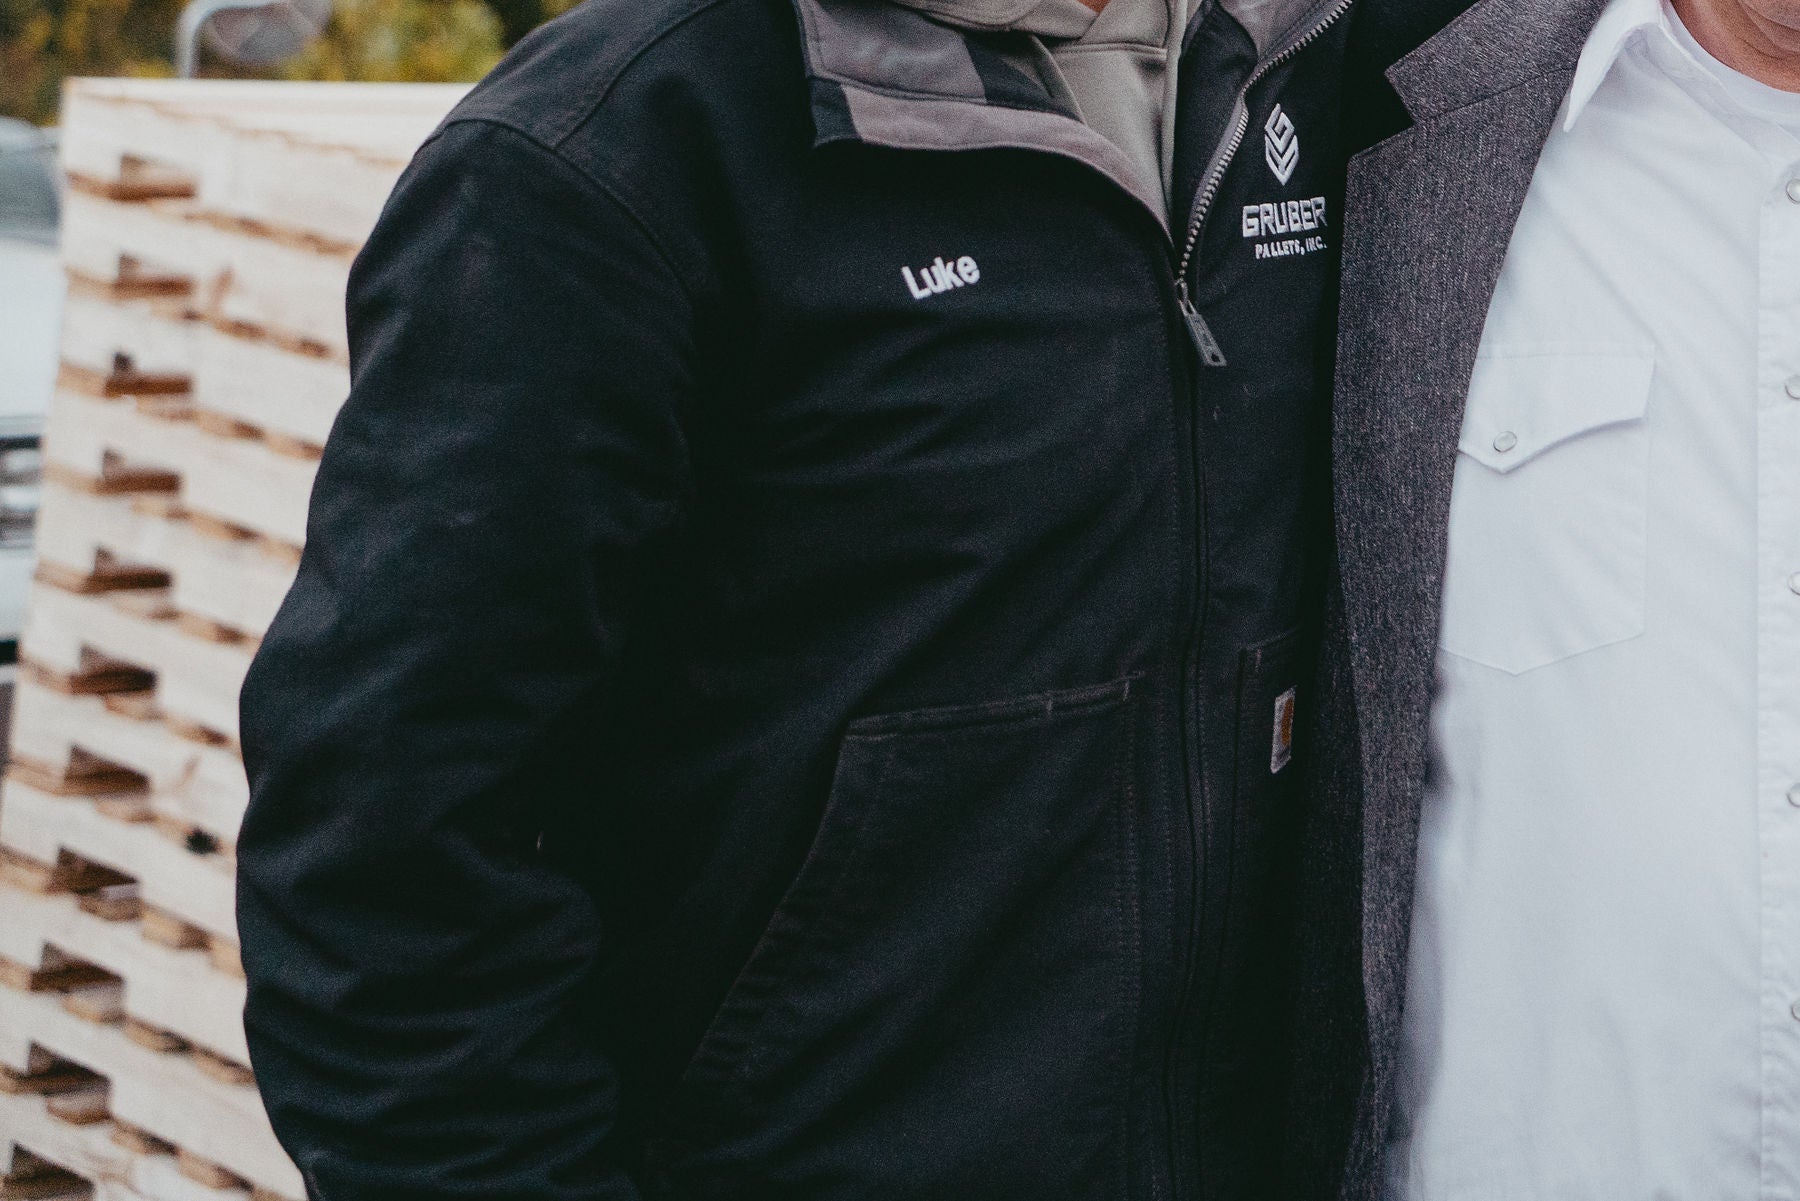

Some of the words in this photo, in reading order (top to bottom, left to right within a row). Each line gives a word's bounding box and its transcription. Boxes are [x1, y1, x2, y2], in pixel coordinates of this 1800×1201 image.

[1242, 196, 1328, 238] GRUBER
[1255, 239, 1305, 260] PALLETS,
[1305, 235, 1327, 252] INC.
[901, 255, 980, 300] Luke
